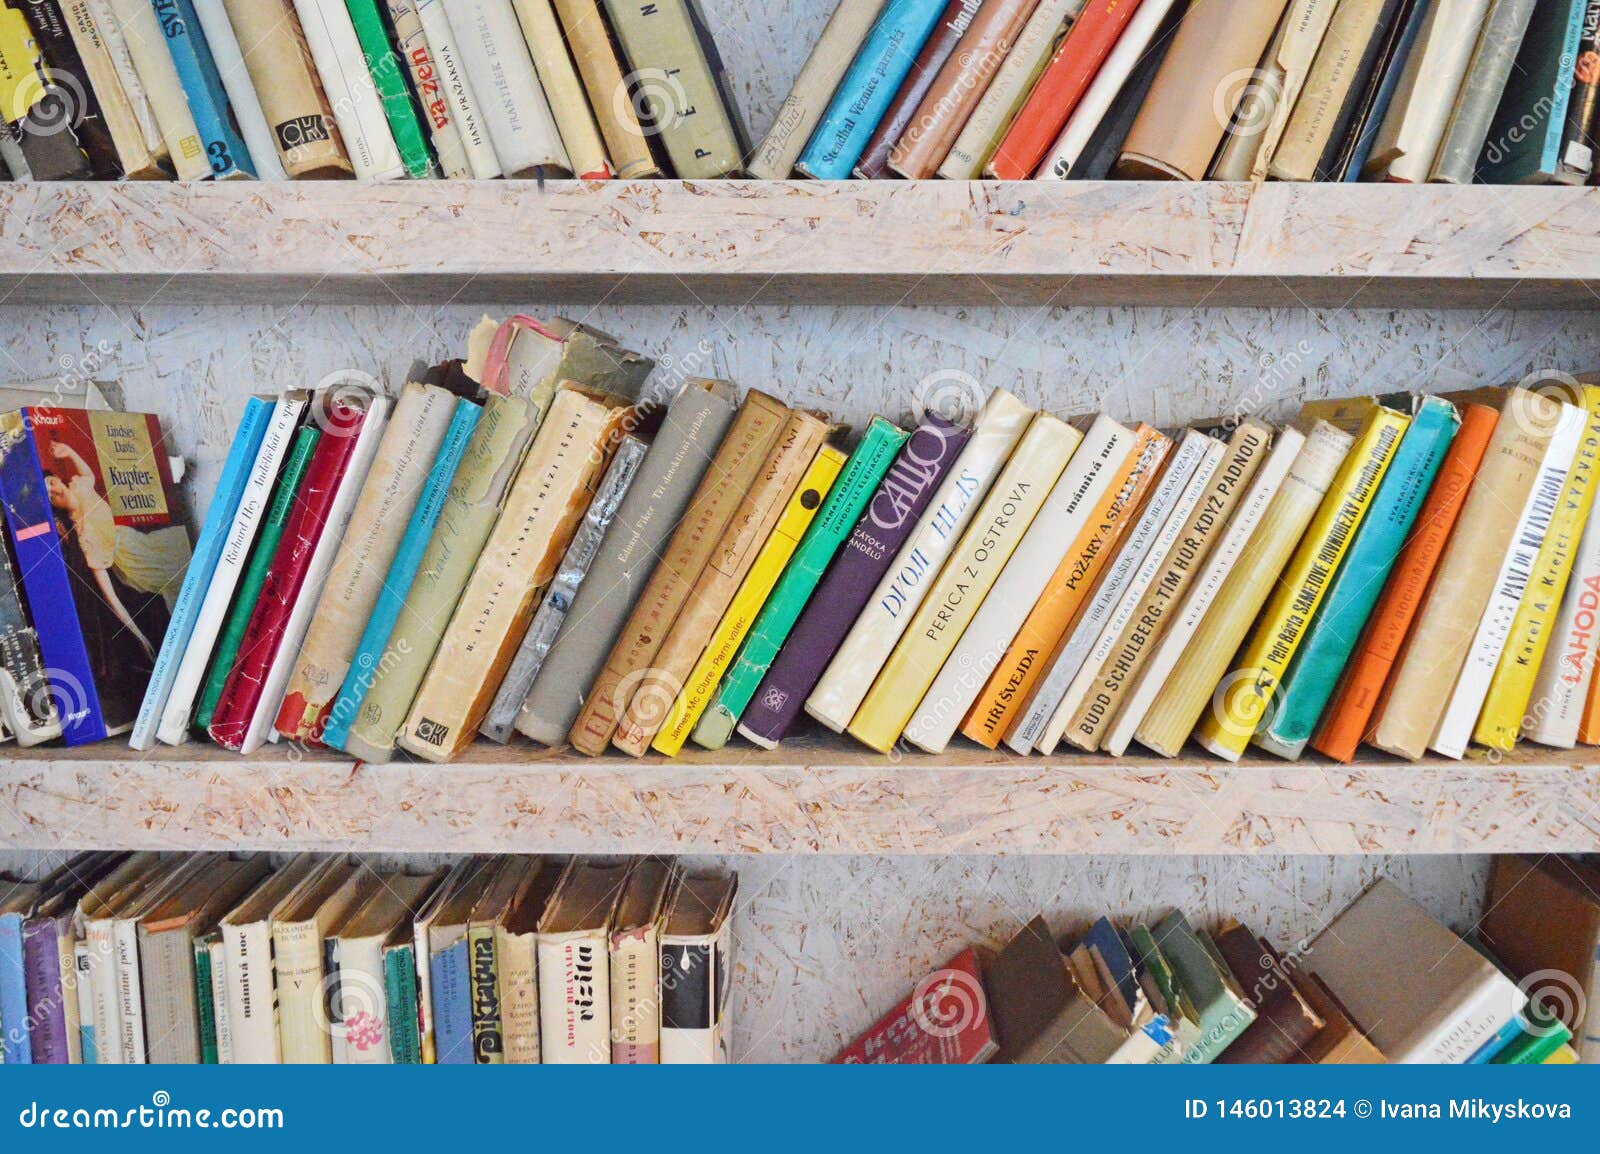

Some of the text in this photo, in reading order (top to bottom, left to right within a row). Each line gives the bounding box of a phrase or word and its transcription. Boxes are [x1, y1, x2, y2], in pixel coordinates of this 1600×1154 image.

[70, 4, 87, 32] DAVID
[78, 1, 101, 49] WAGONER
[947, 13, 974, 37] Jan
[465, 114, 482, 145] HANA
[823, 118, 855, 165] Stendhal
[849, 76, 879, 116] Věznice
[208, 140, 233, 174] 3
[106, 424, 136, 439] Lindsey
[113, 441, 136, 453] Davis
[108, 464, 153, 491] Kupfer-
[120, 493, 157, 510] venus
[226, 520, 250, 566] Richard
[243, 498, 260, 521] Hey
[282, 398, 294, 417] spo
[518, 507, 539, 541] SAMA
[538, 464, 559, 498] MEZI
[556, 413, 582, 457] VŠEMI
[618, 530, 641, 563] Eduard
[635, 504, 655, 529] Fiker
[659, 439, 690, 484] detektivní
[1066, 433, 1120, 515] mámivá noc
[821, 505, 837, 529] HANA
[832, 504, 854, 536] JAHODY
[853, 526, 888, 553] ZÁTOKA
[1388, 505, 1399, 521] EVA
[650, 569, 681, 617] MARTIN
[691, 509, 713, 541] GARD
[925, 480, 1031, 641] PERICA Z OSTROVA
[1066, 537, 1103, 591] POŽÁRY
[1101, 523, 1112, 538] A
[1101, 554, 1134, 603] JANOUŠEK
[1149, 498, 1164, 517] BEZ
[1266, 642, 1291, 666] Petr
[1292, 562, 1331, 616] SAMETOVÉ
[1372, 424, 1401, 465] divadla
[1080, 693, 1111, 735] BUDD
[1194, 494, 1227, 536] KDYŽ
[1218, 434, 1260, 497] PADNOU
[1516, 619, 1541, 666] Karel
[1541, 534, 1569, 586] Krejčí
[1094, 635, 1113, 661] JOHN
[1112, 591, 1139, 630] CREASEY
[1478, 605, 1505, 662] SUSAN
[1563, 573, 1600, 684] LAHODA
[670, 710, 691, 740] James
[685, 696, 700, 709] Mc
[696, 671, 715, 695] Clure
[983, 702, 1006, 733] JIŘÍ
[999, 648, 1039, 701] ŠVEJDA
[124, 970, 135, 1015] povinné
[242, 963, 251, 1018] mámivá
[474, 936, 501, 1063] Diktatura
[565, 945, 573, 1003] BRANALD
[574, 946, 593, 1020] vizita
[628, 998, 635, 1010] ve
